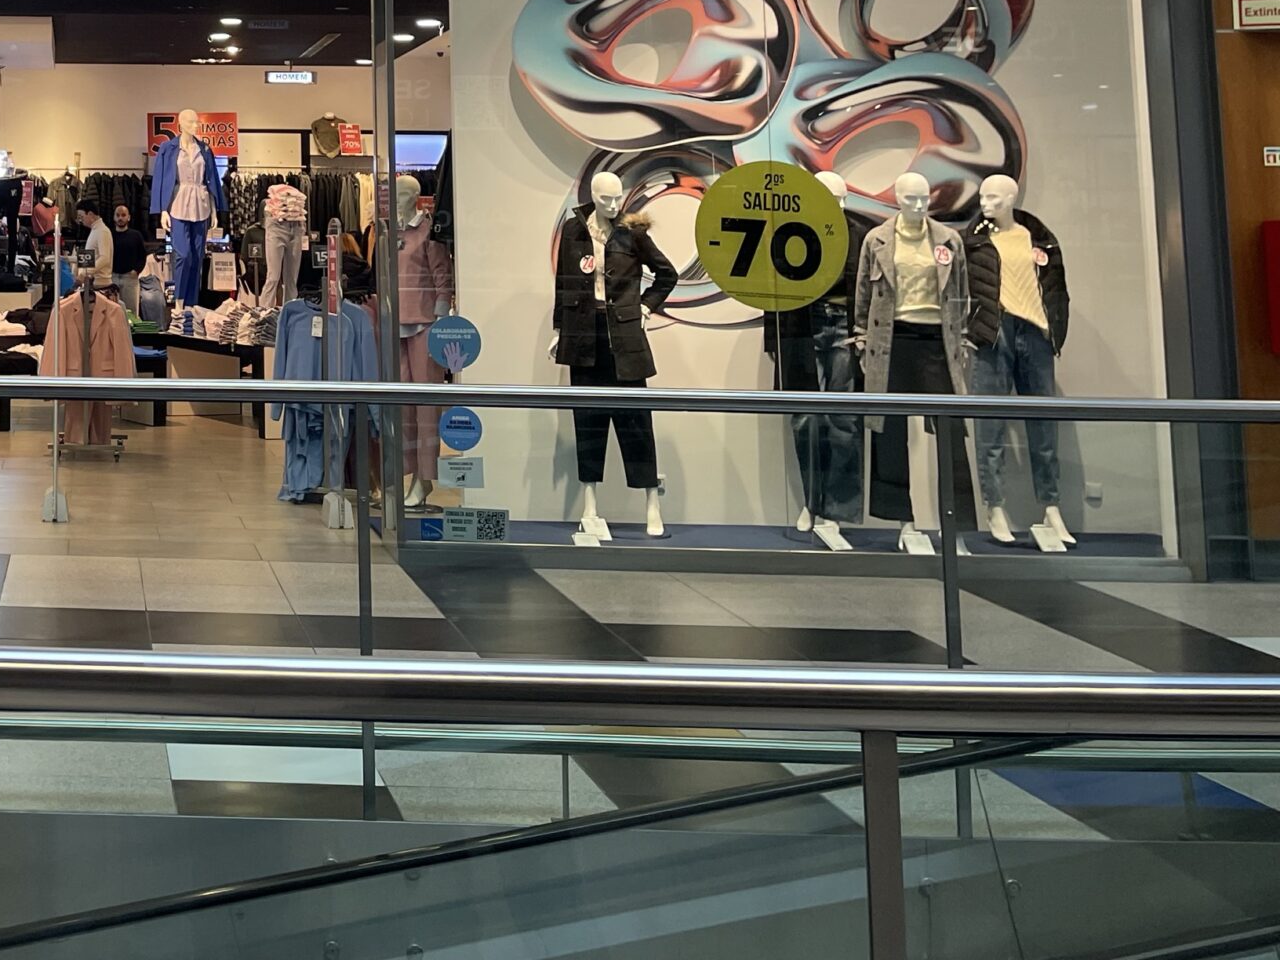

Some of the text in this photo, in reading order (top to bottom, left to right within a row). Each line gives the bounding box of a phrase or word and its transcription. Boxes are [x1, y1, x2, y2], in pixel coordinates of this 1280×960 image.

[276, 73, 308, 81] HOMEM
[201, 135, 236, 148] DIAS
[743, 190, 801, 213] SALDOS
[935, 247, 950, 261] 29
